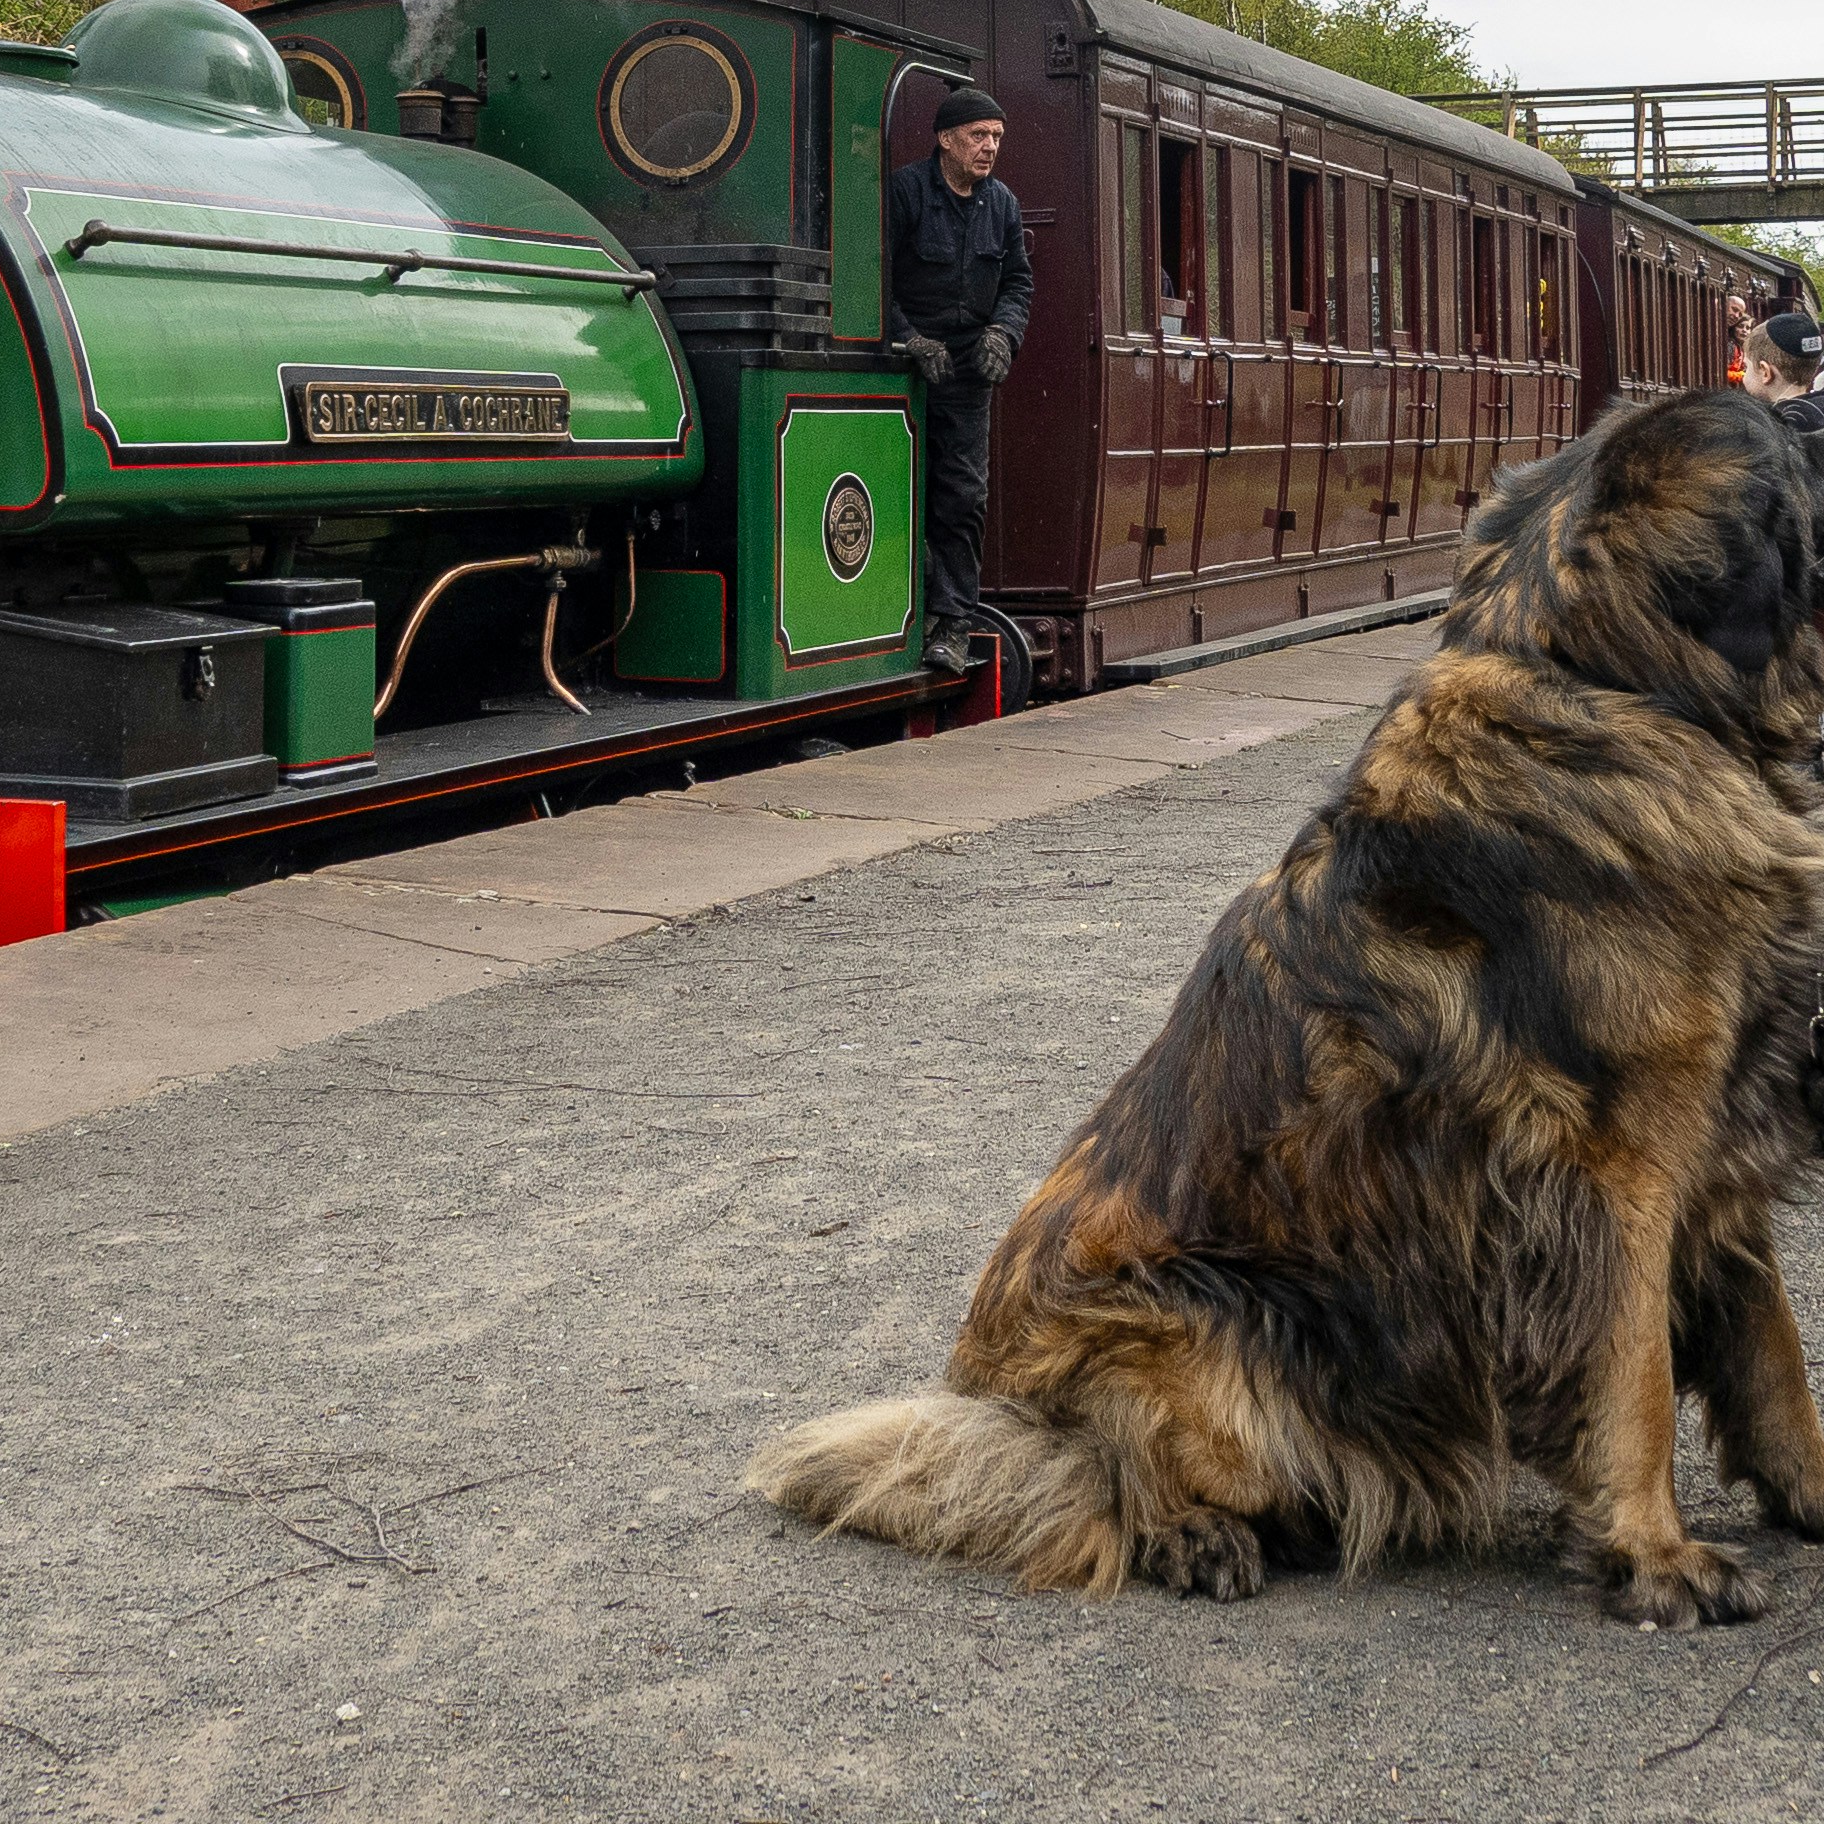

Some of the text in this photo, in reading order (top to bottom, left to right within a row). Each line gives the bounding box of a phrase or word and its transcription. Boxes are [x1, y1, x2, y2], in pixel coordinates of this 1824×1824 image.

[319, 393, 562, 432] SIR CECIL A. COCHRANE
